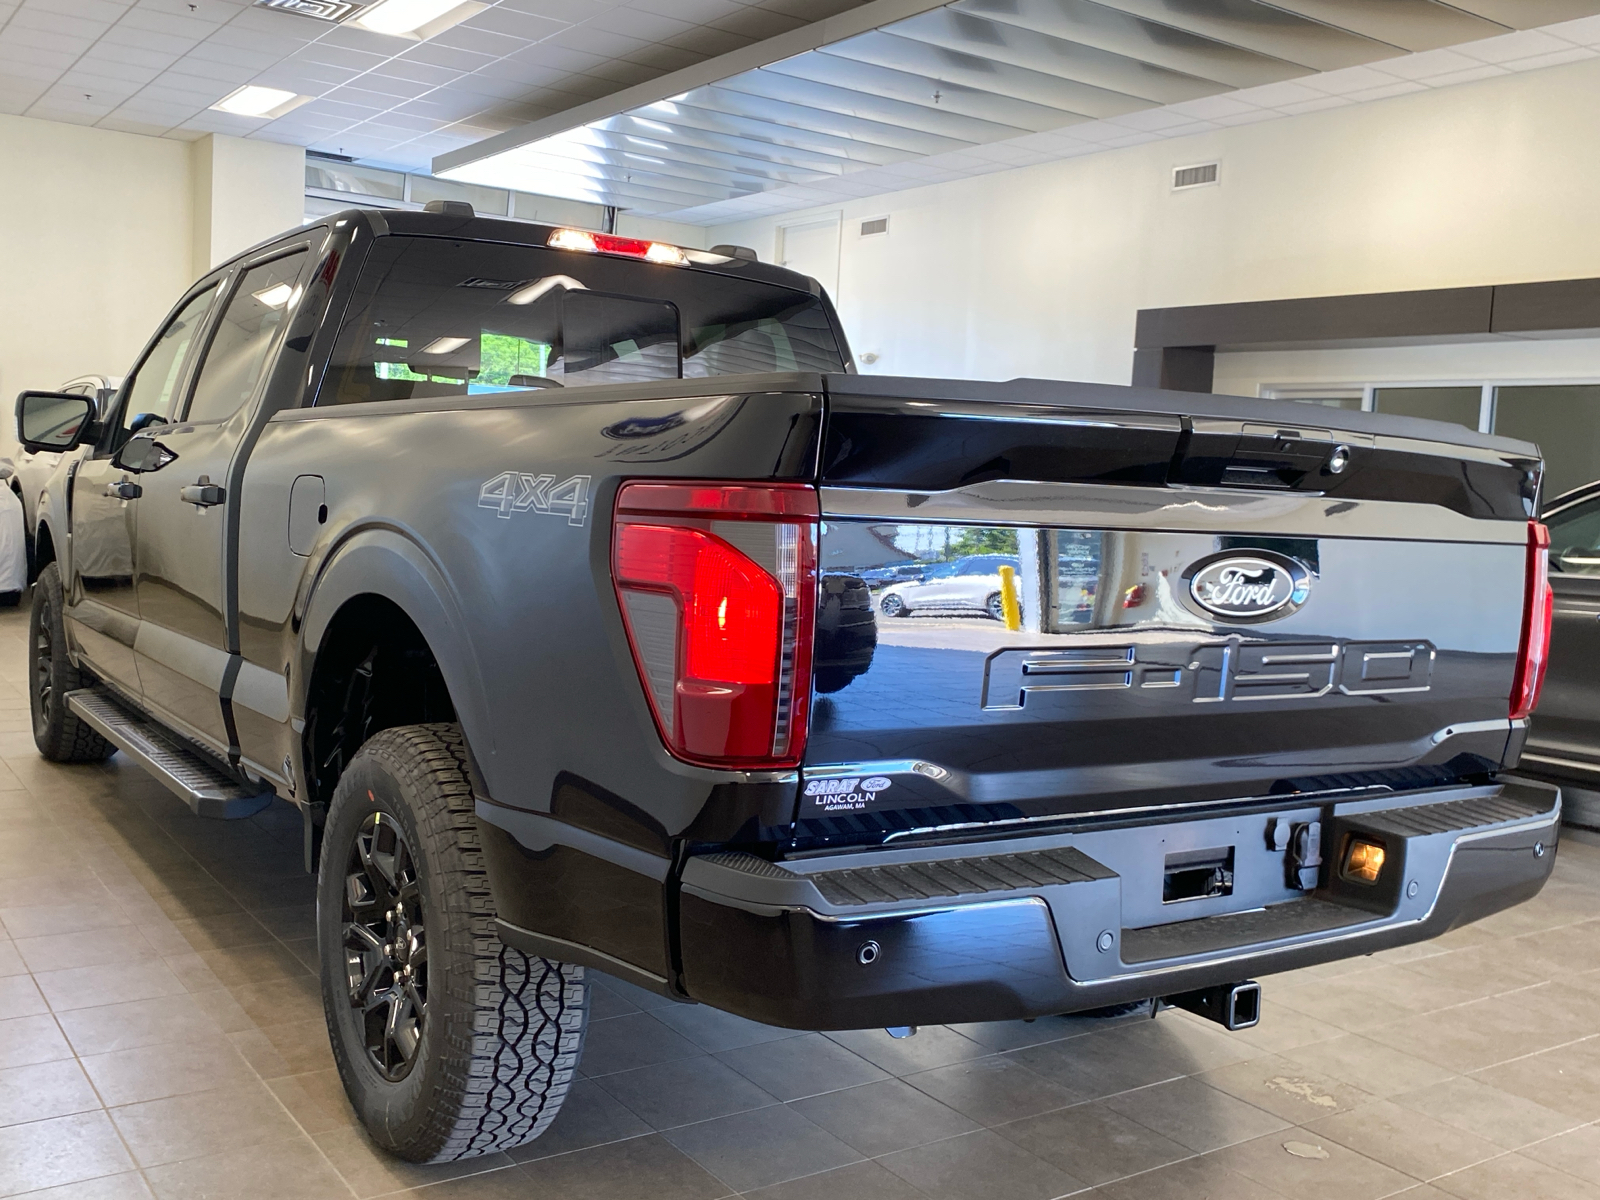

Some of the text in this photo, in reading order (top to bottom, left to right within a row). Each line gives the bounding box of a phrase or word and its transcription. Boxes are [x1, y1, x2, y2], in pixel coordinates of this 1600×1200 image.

[1211, 566, 1275, 606] Ford
[981, 639, 1436, 711] F-150
[804, 778, 860, 796] SARAT
[815, 792, 876, 805] LINCOLN
[824, 803, 854, 811] AGAWAM,
